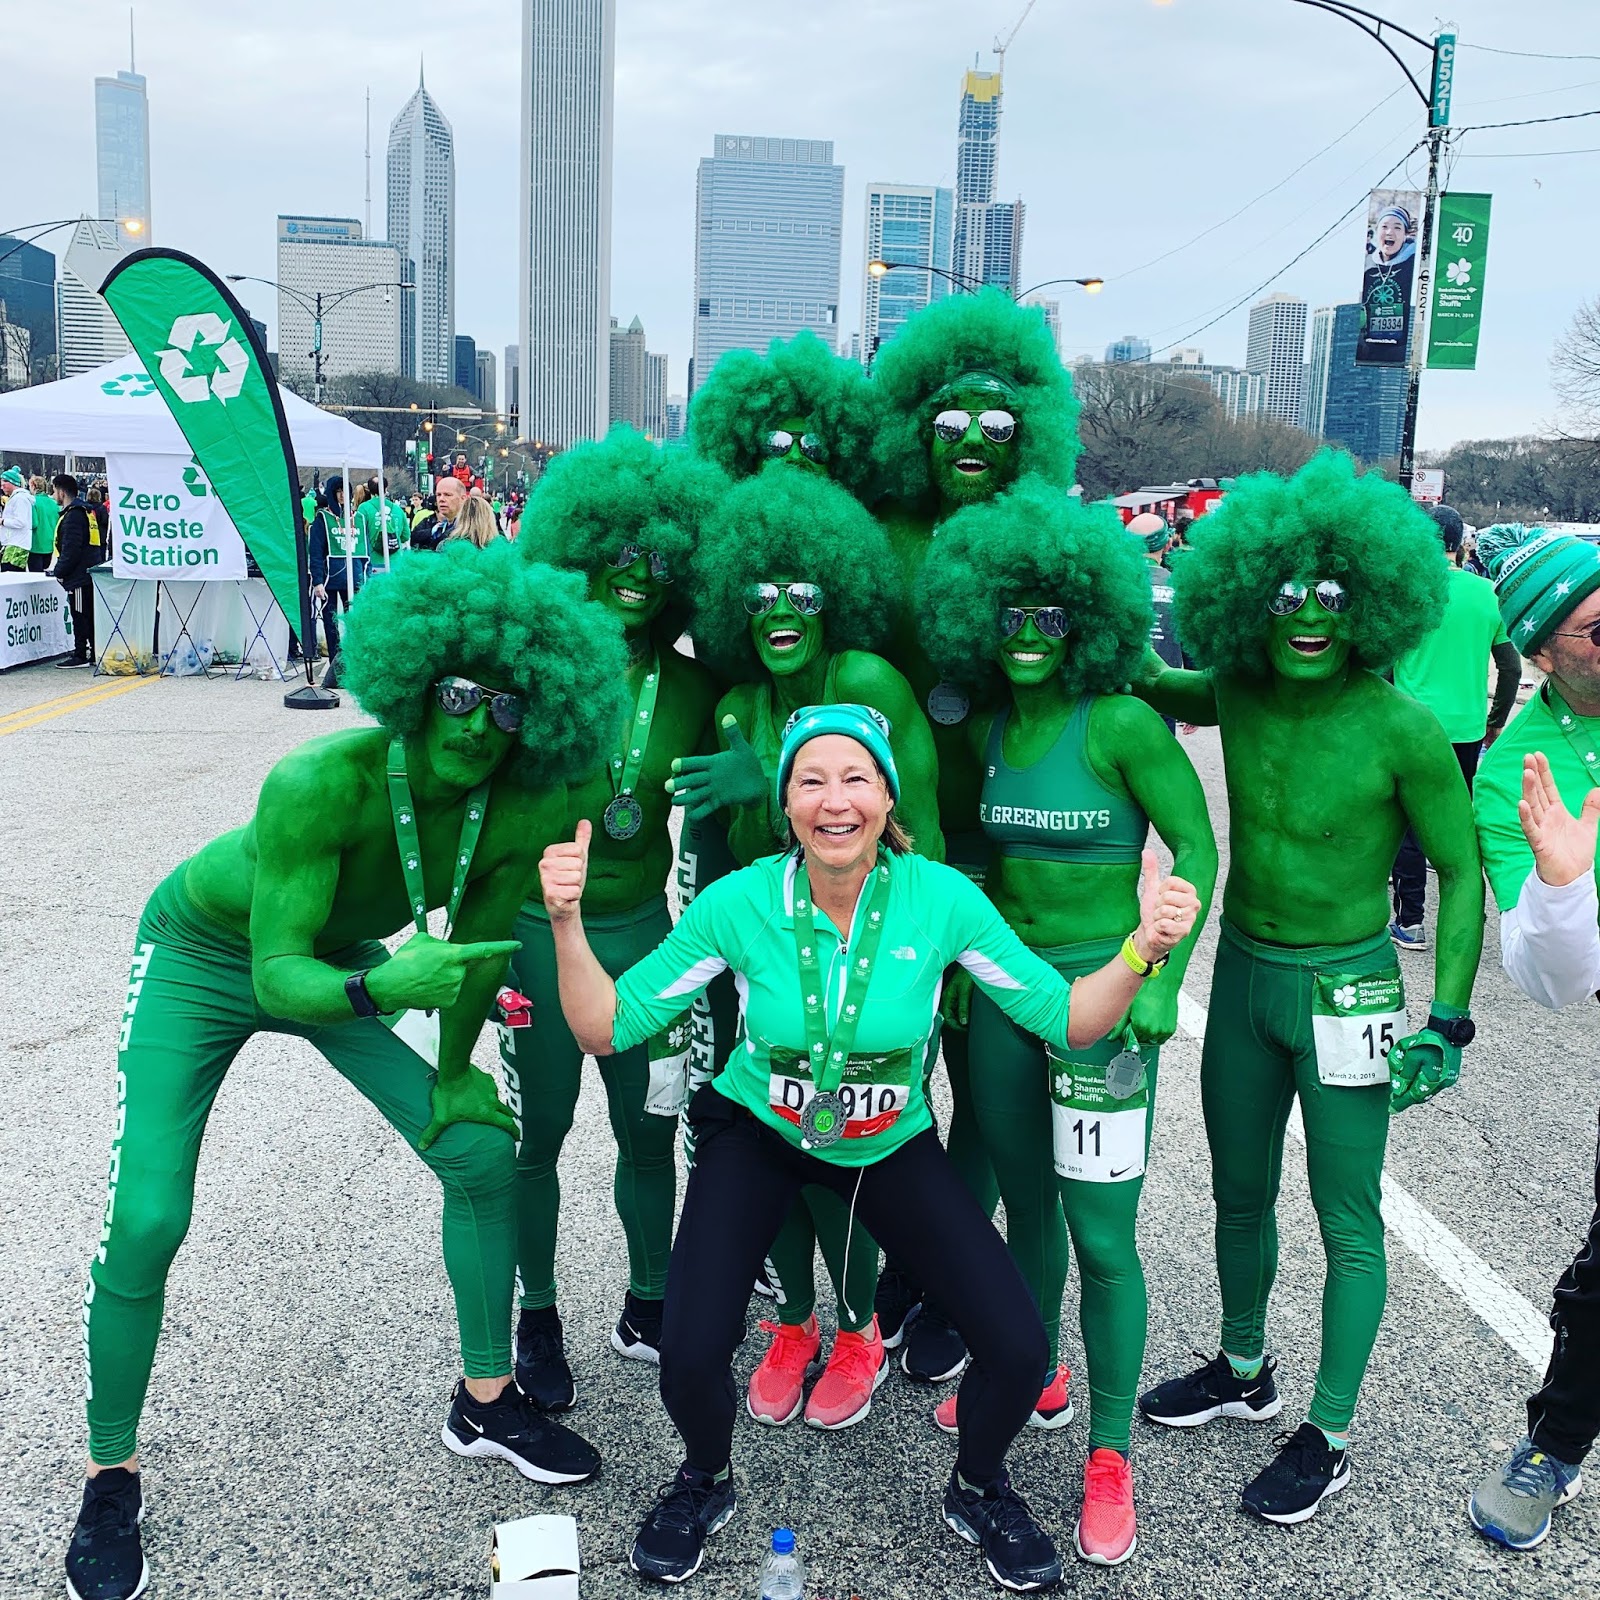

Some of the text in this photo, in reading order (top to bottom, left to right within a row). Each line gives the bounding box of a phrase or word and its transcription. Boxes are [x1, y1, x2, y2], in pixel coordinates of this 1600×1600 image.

[1437, 43, 1454, 116] C521
[1452, 226, 1473, 243] 40
[1439, 293, 1472, 301] Shamrock
[1371, 318, 1402, 331] F 19334
[118, 486, 181, 511] Zero
[119, 514, 204, 539] Waste
[121, 542, 219, 566] Station
[5, 593, 59, 619] Zero Waste
[7, 621, 42, 647] Station
[980, 803, 1110, 831] E_GREENGUYS
[1358, 980, 1371, 988] Bank
[1358, 986, 1400, 998] Shamrock
[1359, 997, 1390, 1006] Shuffle
[1362, 1022, 1395, 1060] 15
[1074, 1075, 1088, 1083] Bank
[1360, 1072, 1376, 1080] 2019
[1074, 1082, 1110, 1095] Shamro
[783, 1078, 897, 1120] D 910
[1074, 1091, 1104, 1103] Shuffle
[816, 1114, 833, 1129] 40
[1072, 1119, 1101, 1156] 11
[1068, 1165, 1082, 1173] 2019
